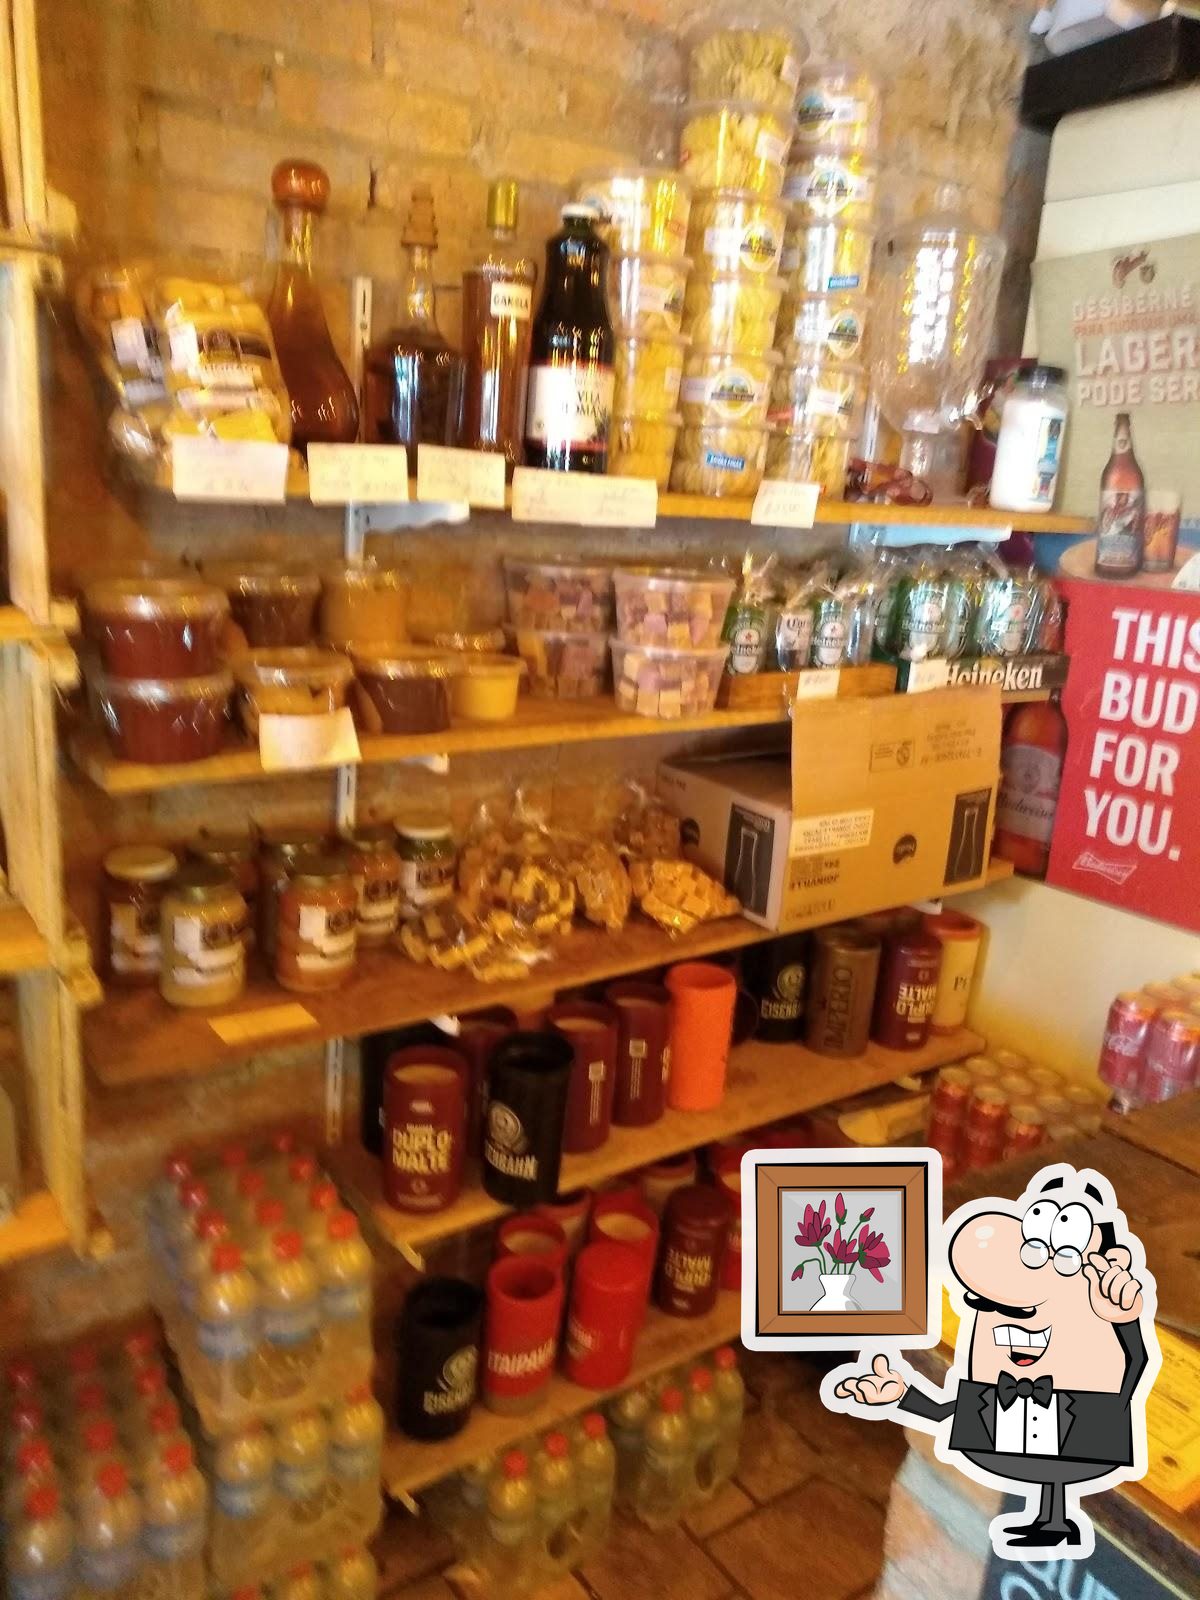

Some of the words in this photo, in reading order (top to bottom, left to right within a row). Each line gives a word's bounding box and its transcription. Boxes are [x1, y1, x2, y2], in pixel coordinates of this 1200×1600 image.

[1075, 327, 1199, 377] LAGER
[1078, 376, 1143, 407] PODE
[1112, 606, 1200, 673] THIS
[946, 661, 1043, 690] Heineken
[1099, 669, 1199, 735] BUD
[1089, 729, 1180, 797] FOR
[1084, 786, 1181, 862] YOU.
